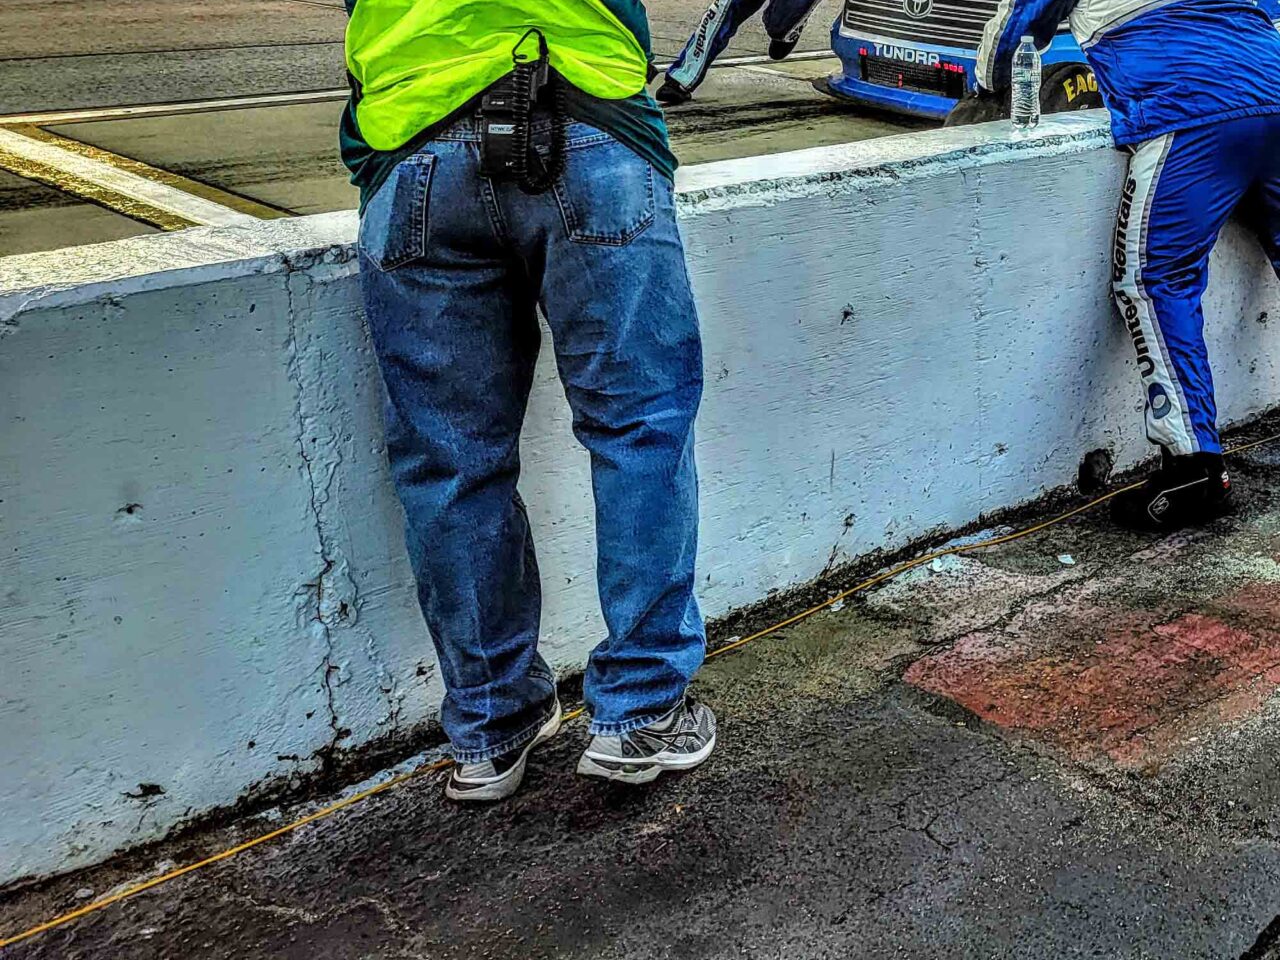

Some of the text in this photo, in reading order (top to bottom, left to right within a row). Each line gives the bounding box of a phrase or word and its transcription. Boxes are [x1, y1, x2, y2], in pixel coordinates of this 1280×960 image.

[873, 42, 940, 66] TUNDRA
[1063, 72, 1098, 102] EAG
[1113, 179, 1155, 378] United Rentals
